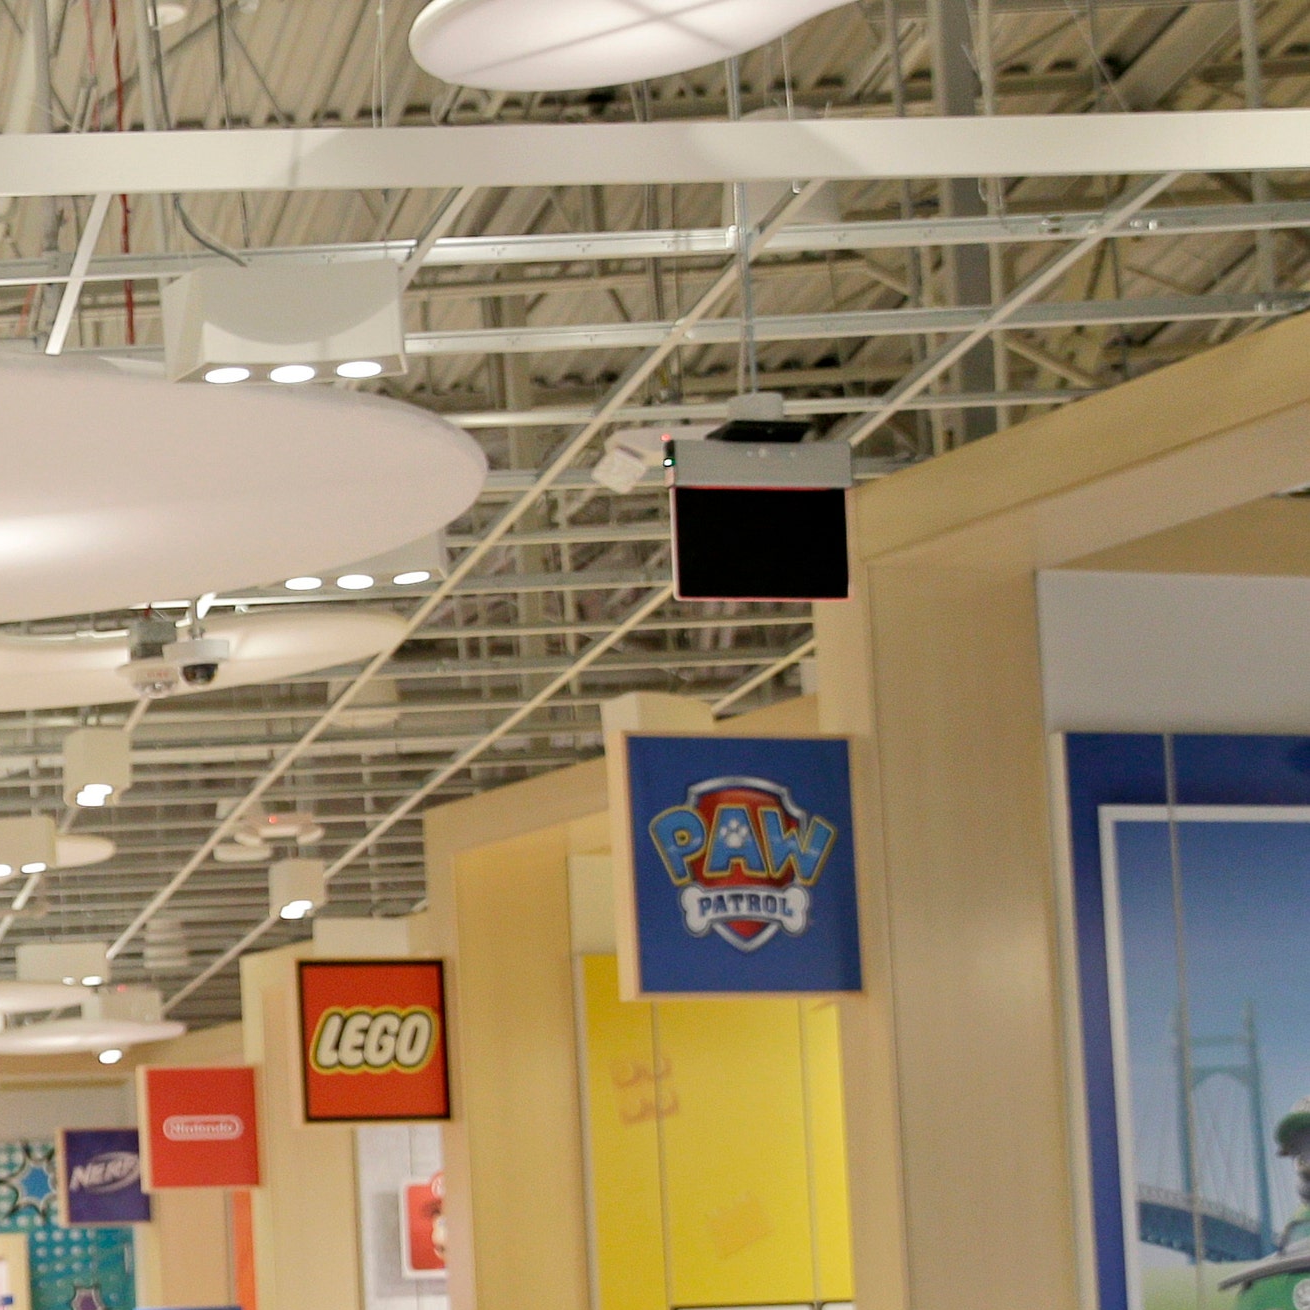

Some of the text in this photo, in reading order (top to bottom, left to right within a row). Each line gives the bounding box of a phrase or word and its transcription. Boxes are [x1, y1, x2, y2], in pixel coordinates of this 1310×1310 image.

[649, 804, 837, 886] PAW
[699, 892, 794, 917] PATROL
[314, 1010, 434, 1069] LEGO
[69, 1158, 133, 1191] NERF
